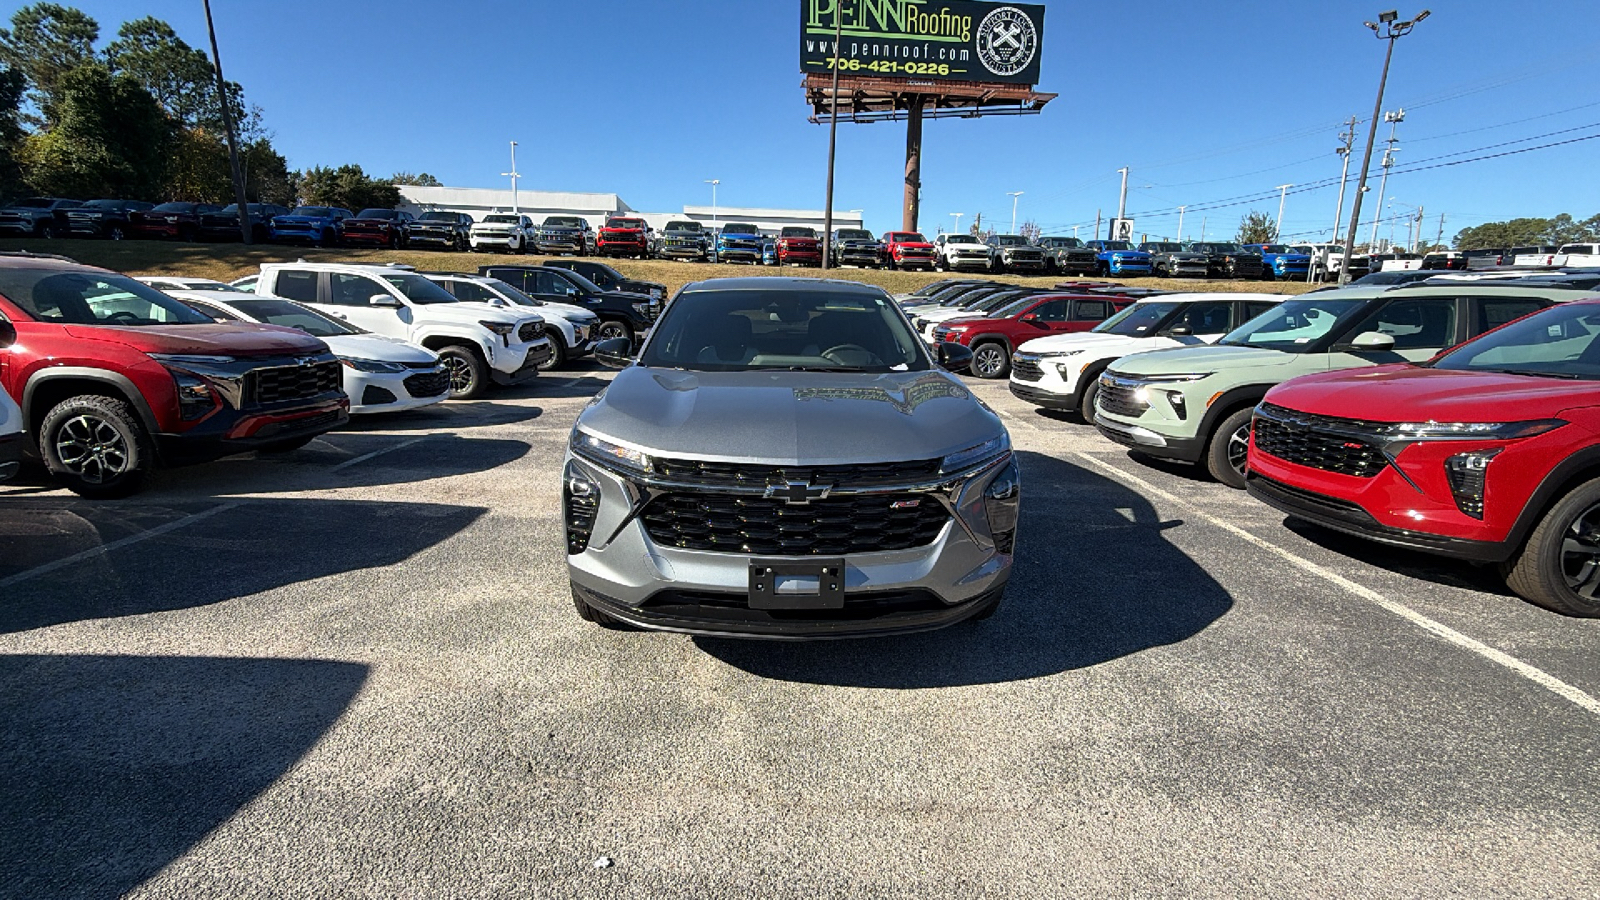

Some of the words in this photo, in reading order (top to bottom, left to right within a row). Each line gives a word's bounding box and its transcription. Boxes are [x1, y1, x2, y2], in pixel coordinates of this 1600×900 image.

[807, 0, 921, 32] PENN
[907, 4, 971, 42] Roofing
[981, 12, 1012, 37] SUPPORT
[1013, 14, 1033, 38] LOCAL
[807, 40, 969, 61] www.pennroof.com
[1021, 51, 1031, 62] GA
[826, 58, 949, 75] 706-421-0226
[890, 499, 920, 508] RS
